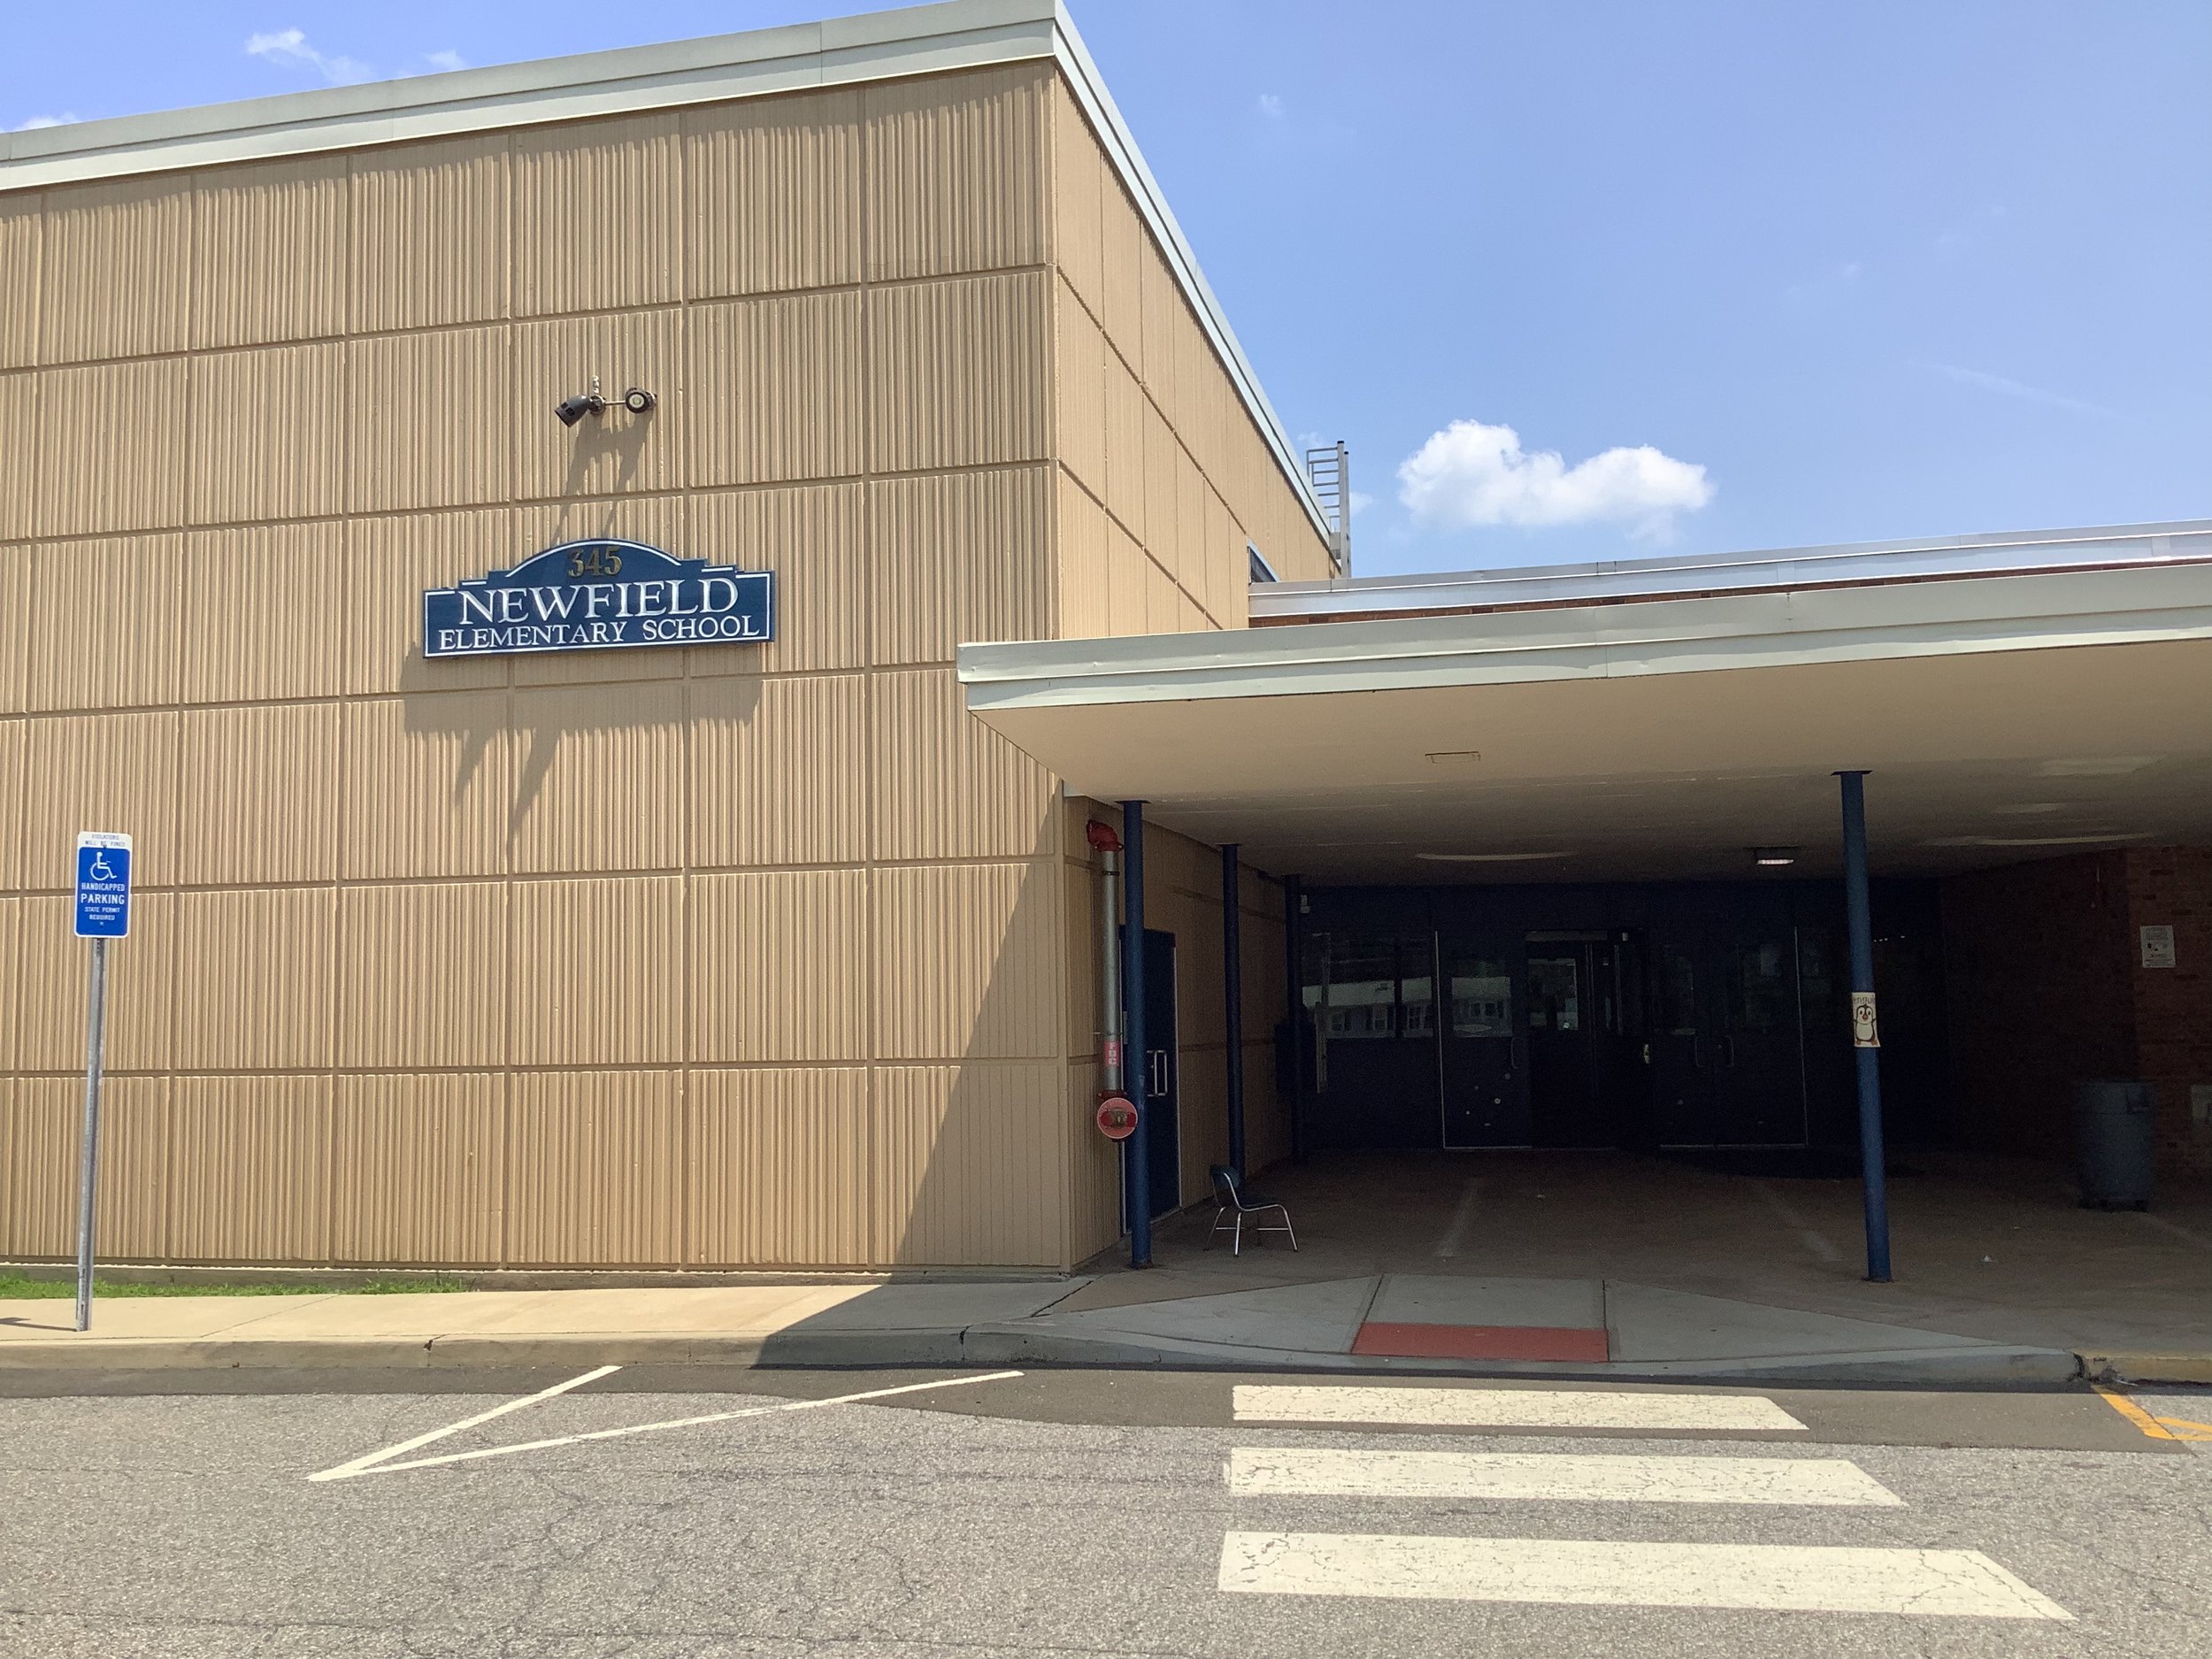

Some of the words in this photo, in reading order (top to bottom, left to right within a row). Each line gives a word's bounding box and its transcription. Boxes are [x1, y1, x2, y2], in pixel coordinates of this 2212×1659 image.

[568, 546, 622, 578] 345
[458, 578, 739, 625] NEWFIELD
[439, 622, 626, 650] ELEMENTARY
[642, 615, 760, 641] SCHOOL
[81, 882, 126, 892] HANDICAPPED
[81, 893, 126, 905] PARKING
